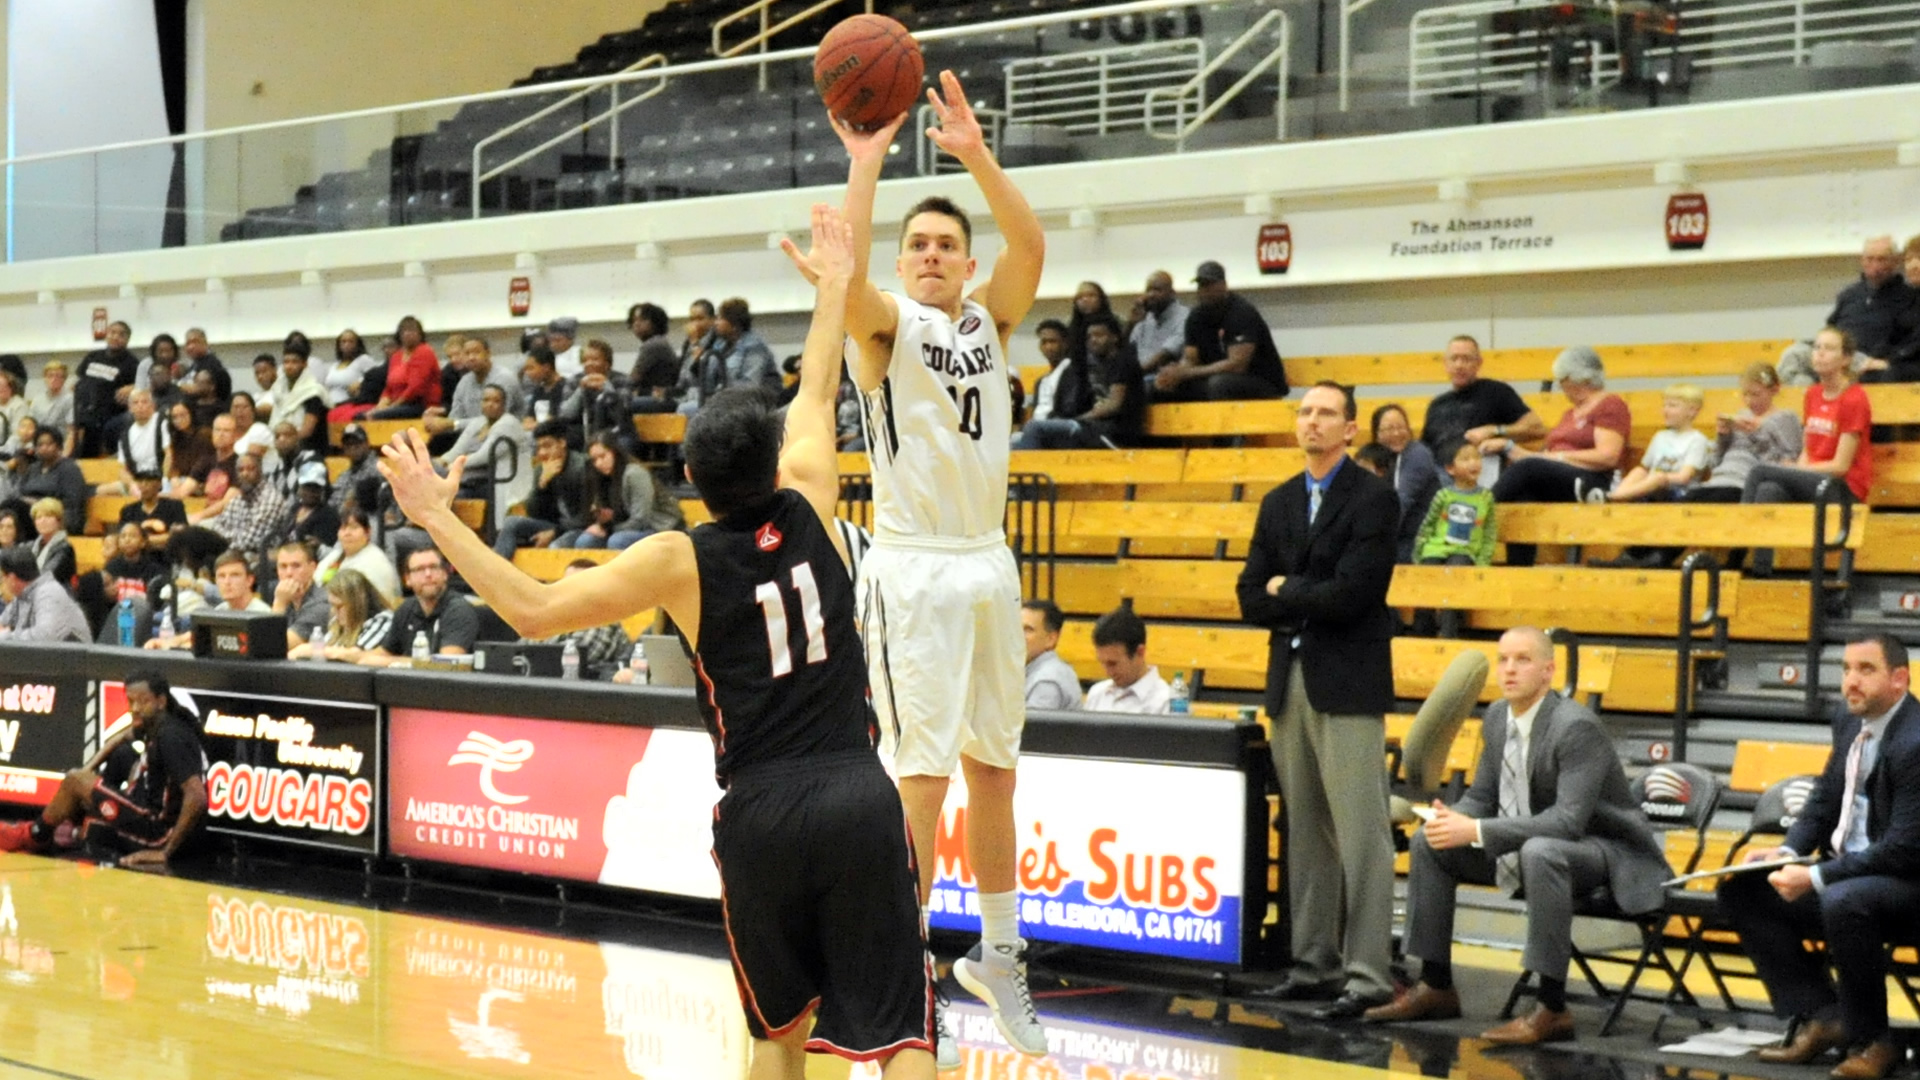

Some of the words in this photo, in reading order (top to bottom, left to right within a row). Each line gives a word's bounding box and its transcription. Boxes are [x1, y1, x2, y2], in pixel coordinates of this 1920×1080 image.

[1411, 220, 1439, 235] The
[1446, 215, 1534, 233] Ahmanson
[1669, 213, 1705, 236] 103
[1261, 241, 1289, 262] 103
[1391, 239, 1482, 256] Foundation
[1490, 235, 1554, 251] Terrace
[756, 561, 828, 678] 11
[278, 740, 363, 775] University
[207, 761, 373, 836] COUGARS
[405, 797, 486, 830] AMERICA'S
[487, 805, 578, 841] CHRISTIAN
[416, 825, 487, 849] CREDIT
[499, 835, 566, 859] UNION
[933, 807, 1070, 892] Me's
[1044, 901, 1143, 940] GLENDORA,
[1144, 911, 1171, 939] CA
[1172, 915, 1222, 945] 91741
